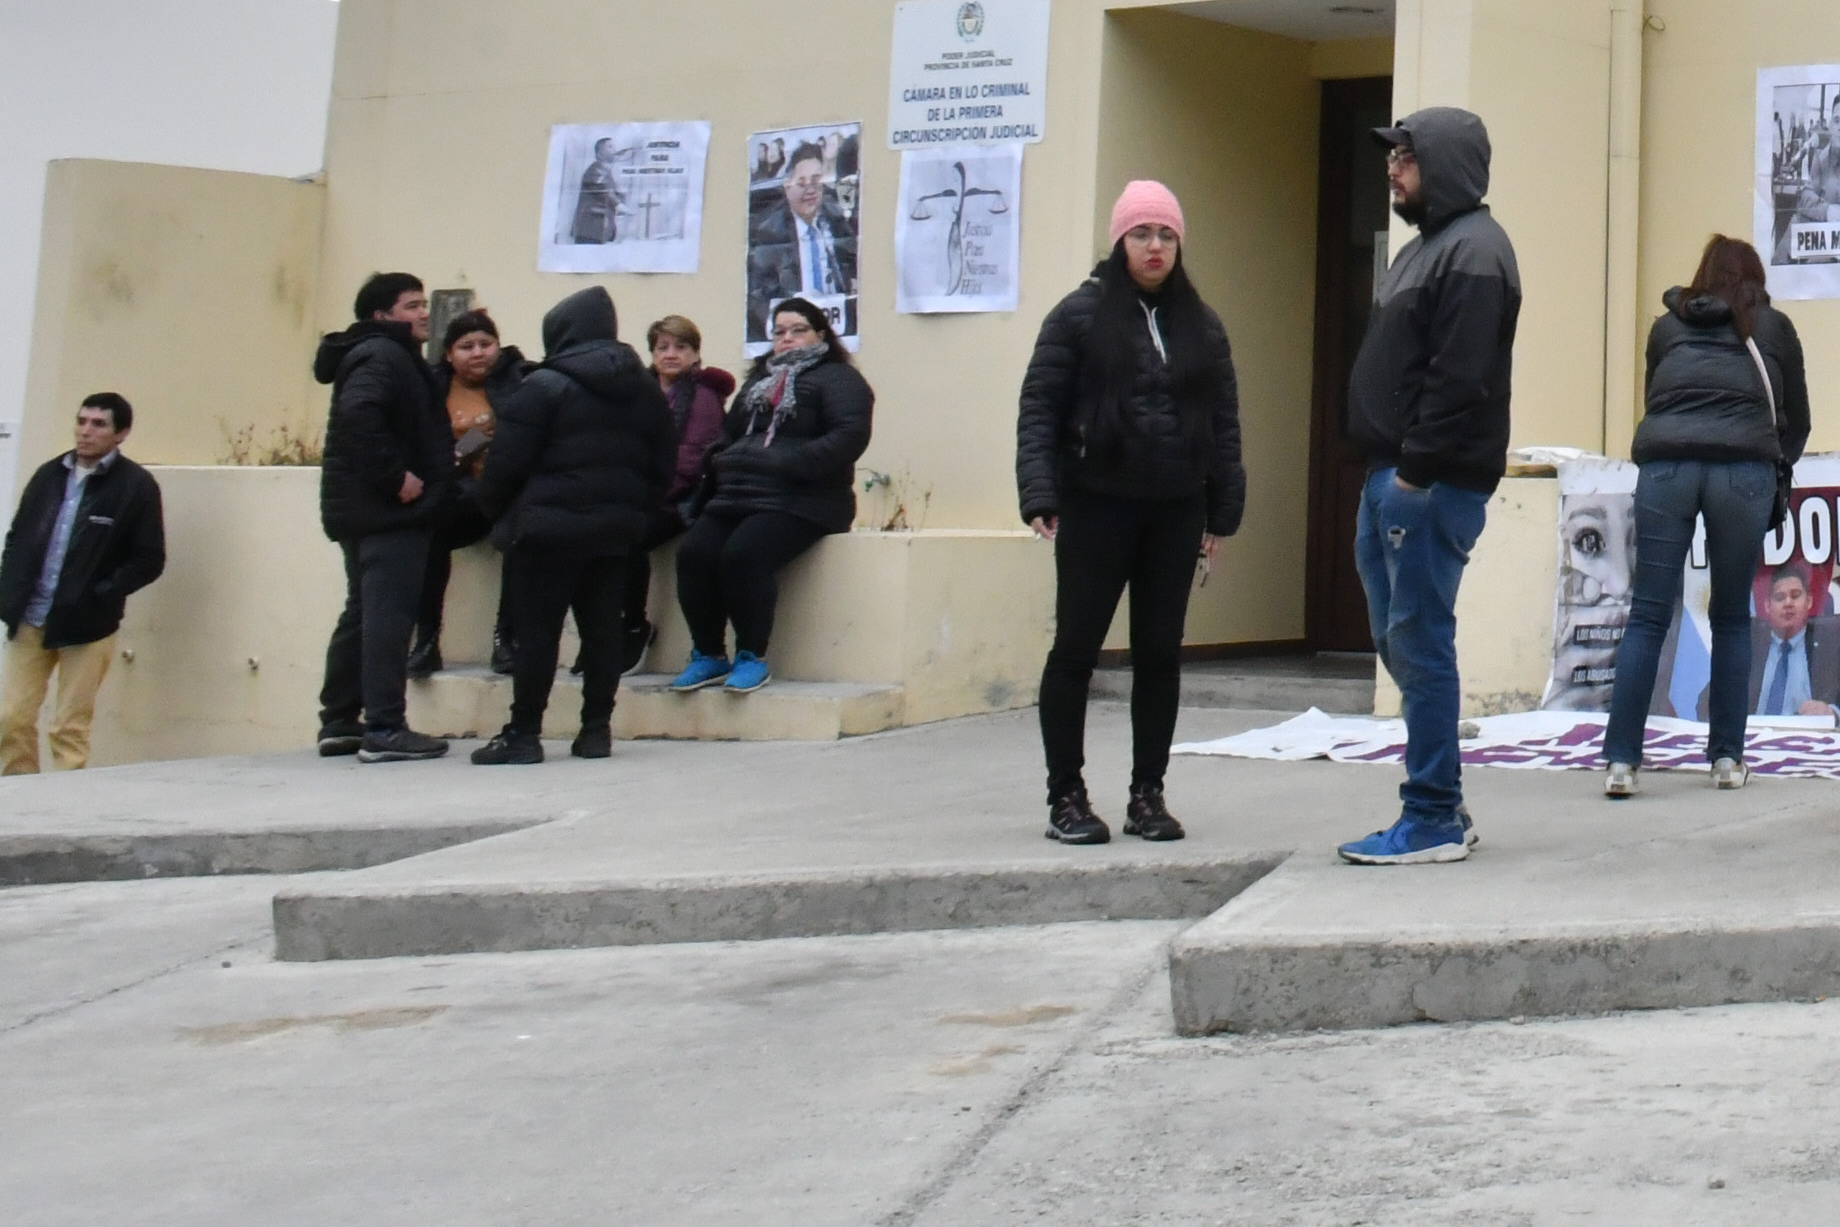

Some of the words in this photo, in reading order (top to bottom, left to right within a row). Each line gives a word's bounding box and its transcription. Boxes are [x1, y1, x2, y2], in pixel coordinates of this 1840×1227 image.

[949, 86, 962, 99] EN
[965, 85, 978, 98] LO
[981, 82, 1030, 98] CRIMINAL
[927, 108, 940, 121] DE
[943, 108, 955, 121] LA
[959, 105, 1003, 119] PRIMERA
[990, 124, 1038, 139] JUDICIAL
[1797, 231, 1826, 251] PENA
